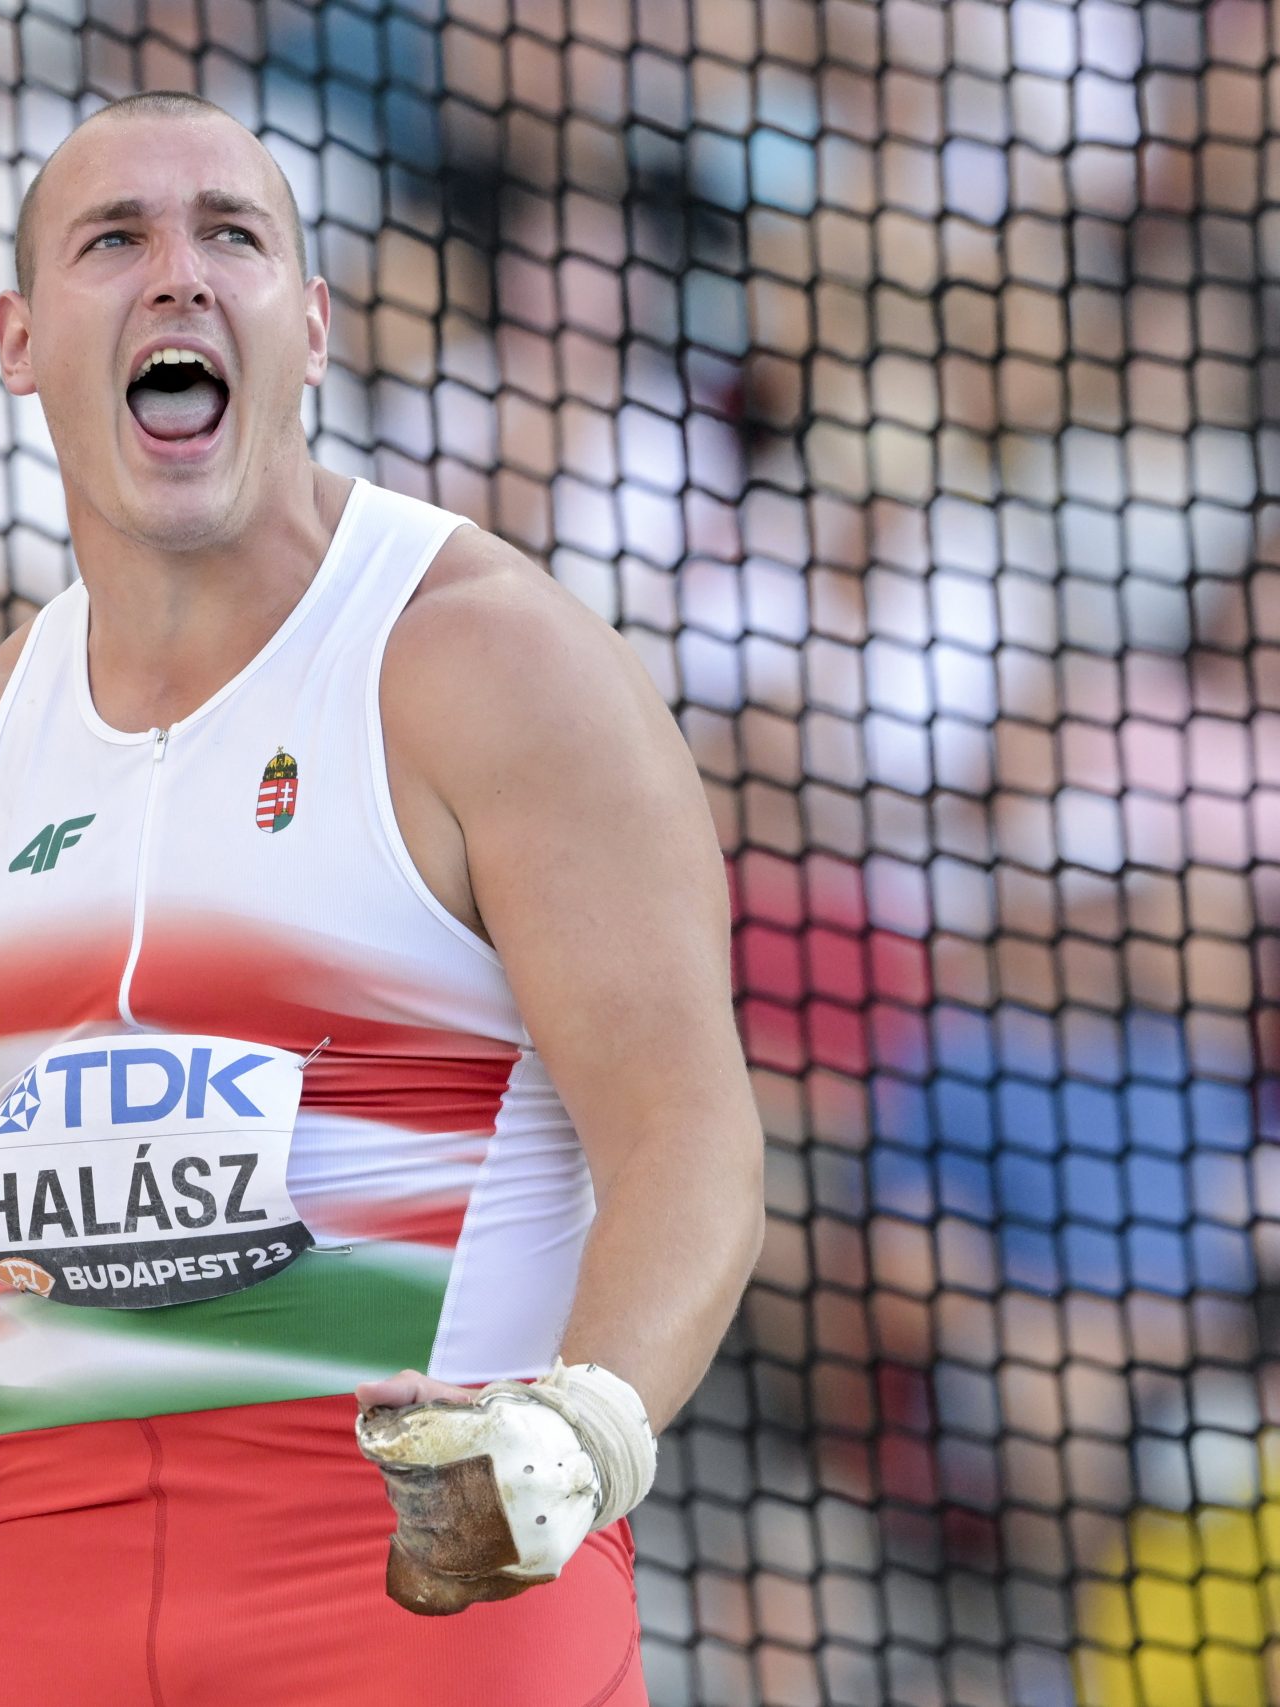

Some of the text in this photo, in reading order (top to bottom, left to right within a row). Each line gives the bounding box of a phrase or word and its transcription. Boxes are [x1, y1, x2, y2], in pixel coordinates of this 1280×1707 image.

[45, 1048, 275, 1128] TDK
[62, 1242, 293, 1290] BUDAPEST 23
